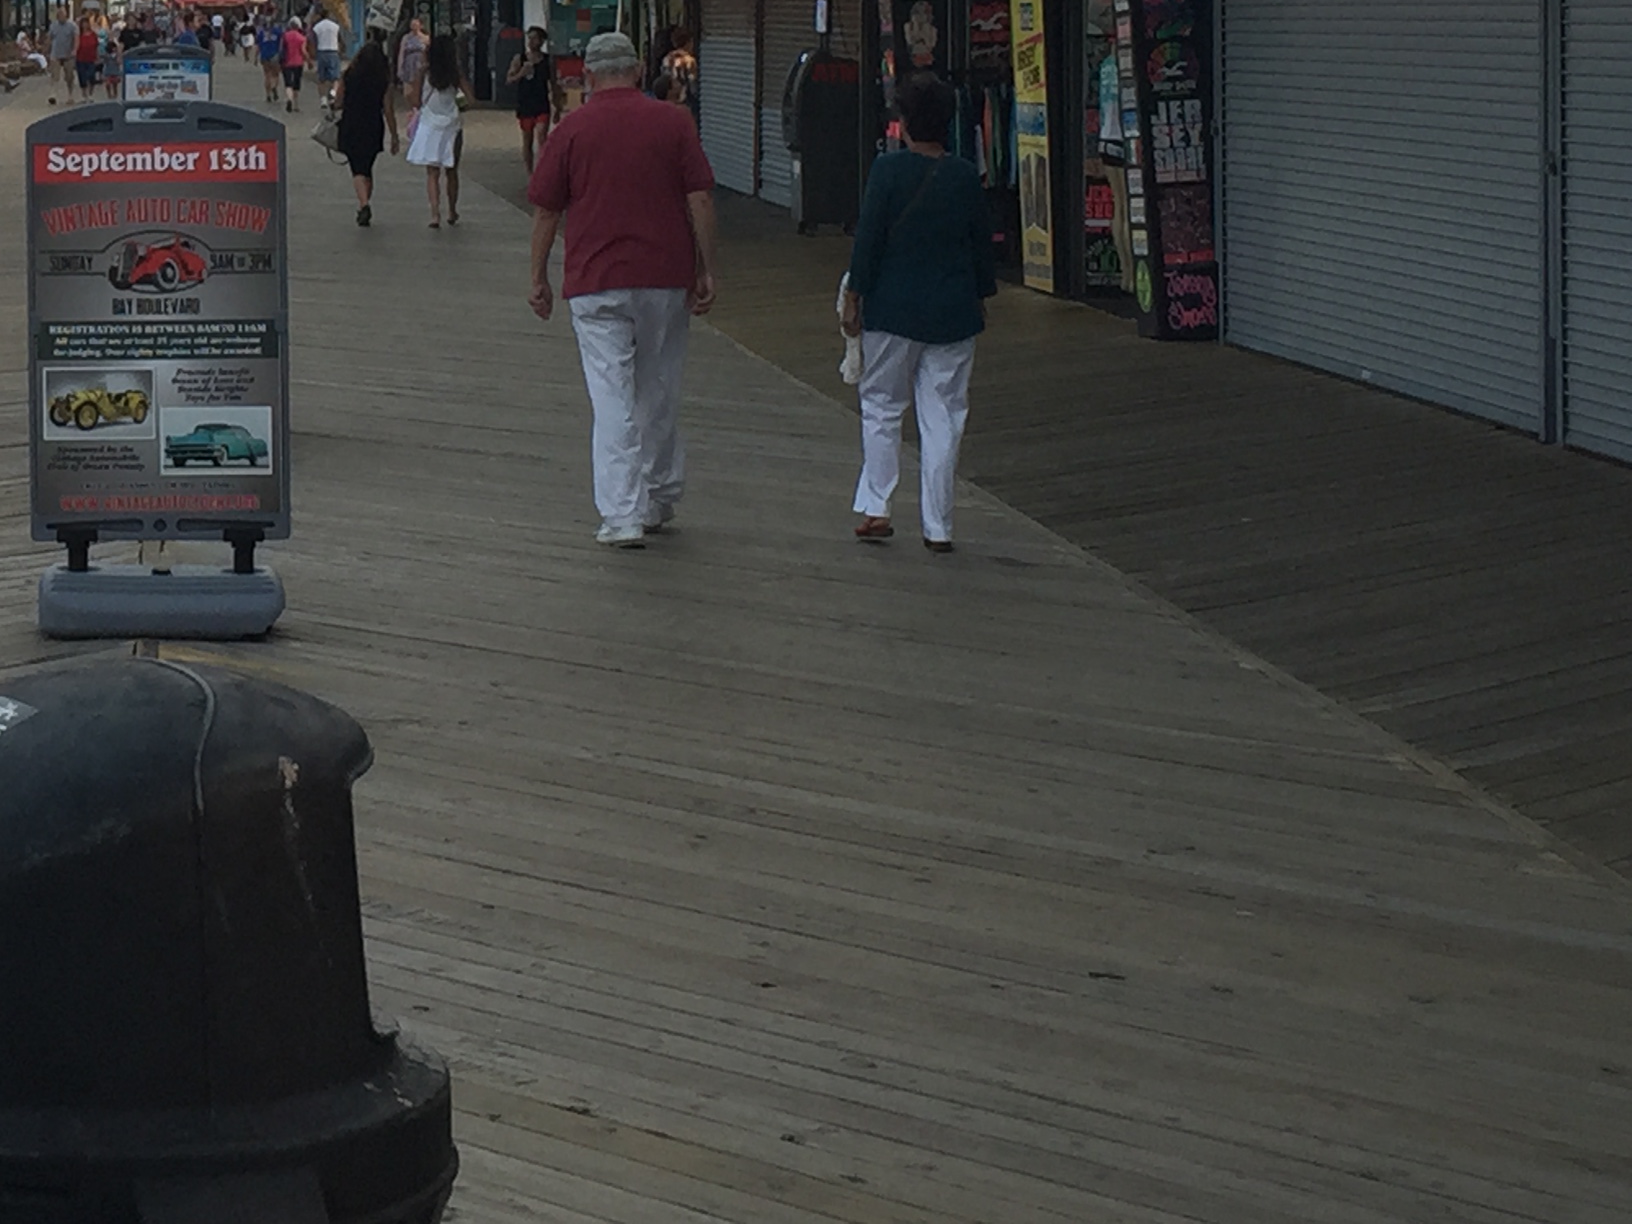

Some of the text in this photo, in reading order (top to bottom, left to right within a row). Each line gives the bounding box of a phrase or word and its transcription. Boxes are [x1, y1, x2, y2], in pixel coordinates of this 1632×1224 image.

[47, 145, 267, 178] September 13th
[42, 198, 272, 237] VINTAGE AUTO CAR SHOW
[136, 297, 201, 316] BOULEVARD
[49, 325, 130, 335] REGISTRATION
[144, 324, 196, 334] BETWEEN
